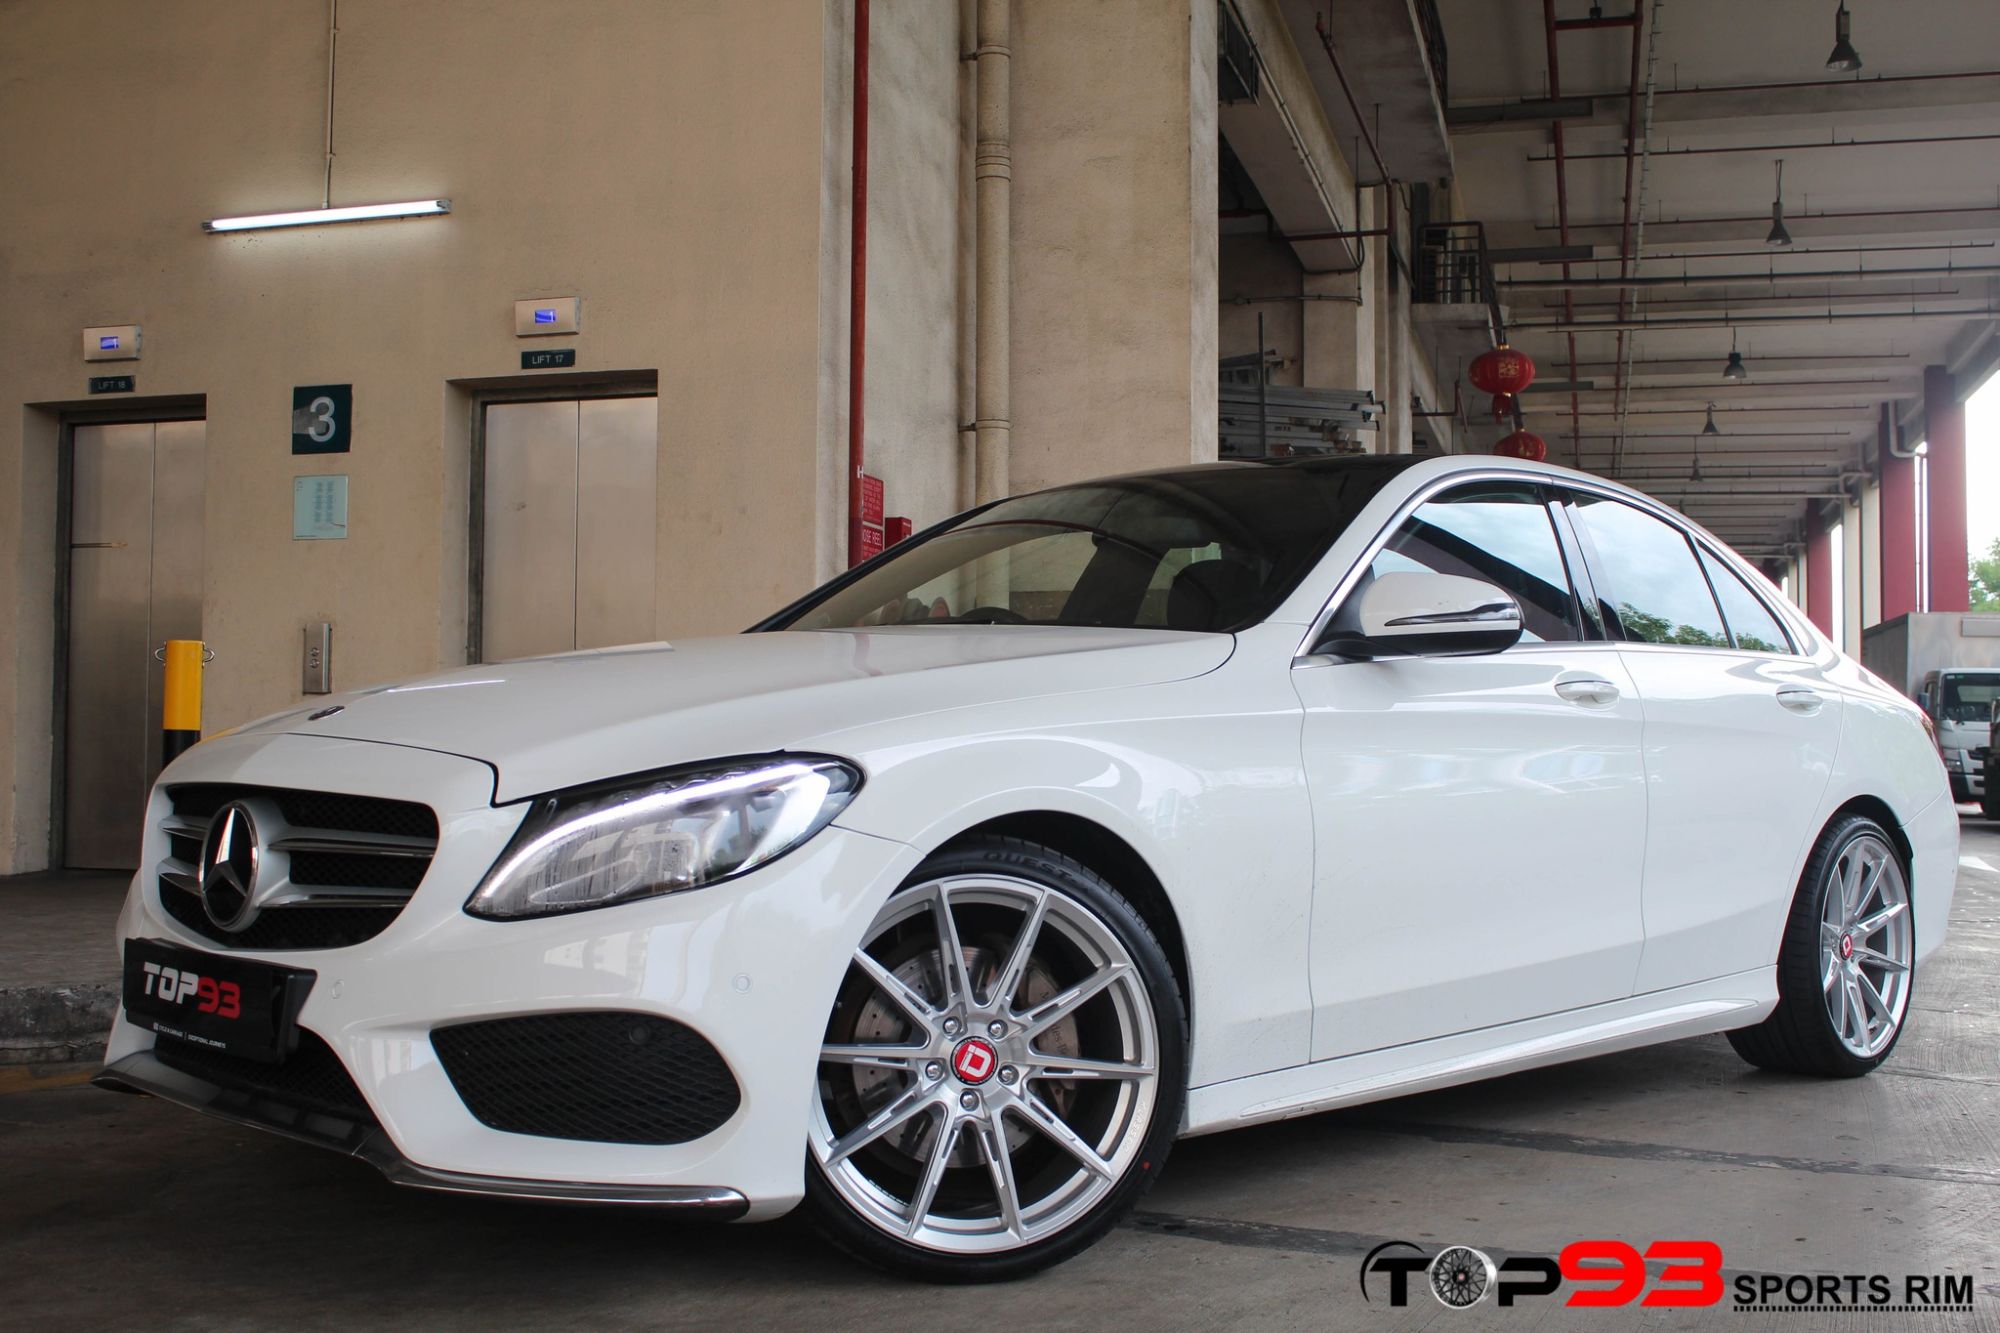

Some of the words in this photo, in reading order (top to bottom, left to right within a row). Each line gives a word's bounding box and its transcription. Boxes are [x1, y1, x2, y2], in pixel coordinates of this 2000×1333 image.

[532, 354, 551, 365] LIFT
[554, 354, 564, 363] 17
[98, 380, 115, 390] LIFT
[308, 396, 336, 443] 3
[143, 961, 241, 1020] TOP93
